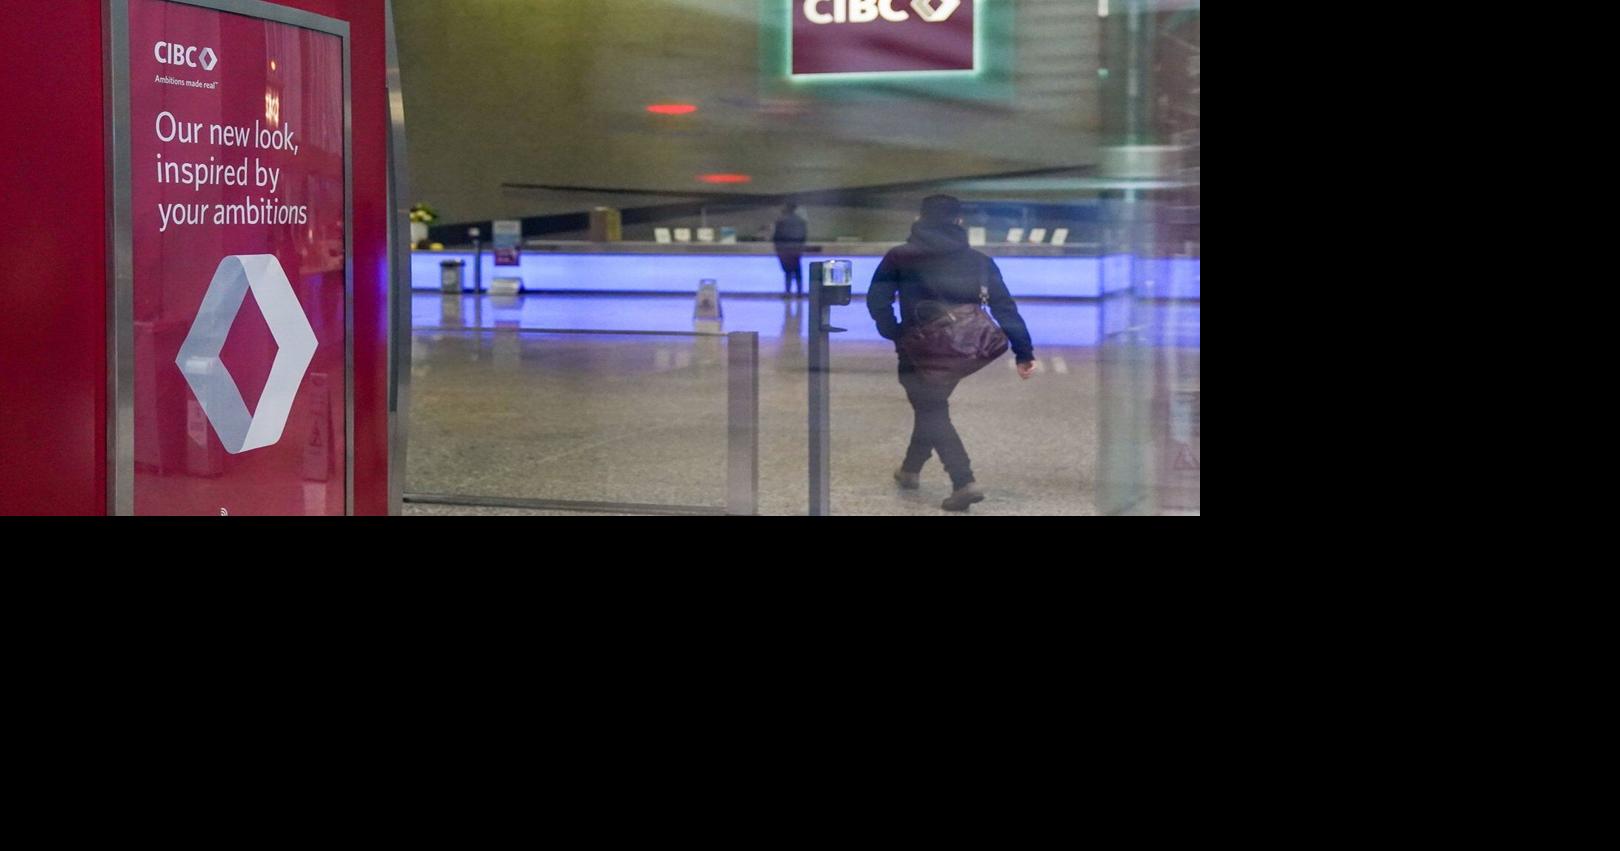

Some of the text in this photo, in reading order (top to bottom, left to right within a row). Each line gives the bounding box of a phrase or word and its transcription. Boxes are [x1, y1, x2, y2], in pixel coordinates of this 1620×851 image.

[803, 0, 910, 24] CIBC
[154, 41, 197, 68] CIBC
[154, 74, 185, 86] Ambitions
[185, 80, 203, 88] made
[155, 111, 299, 155] Our new look,
[156, 153, 280, 193] inspired by
[158, 195, 308, 233] your ambitions
